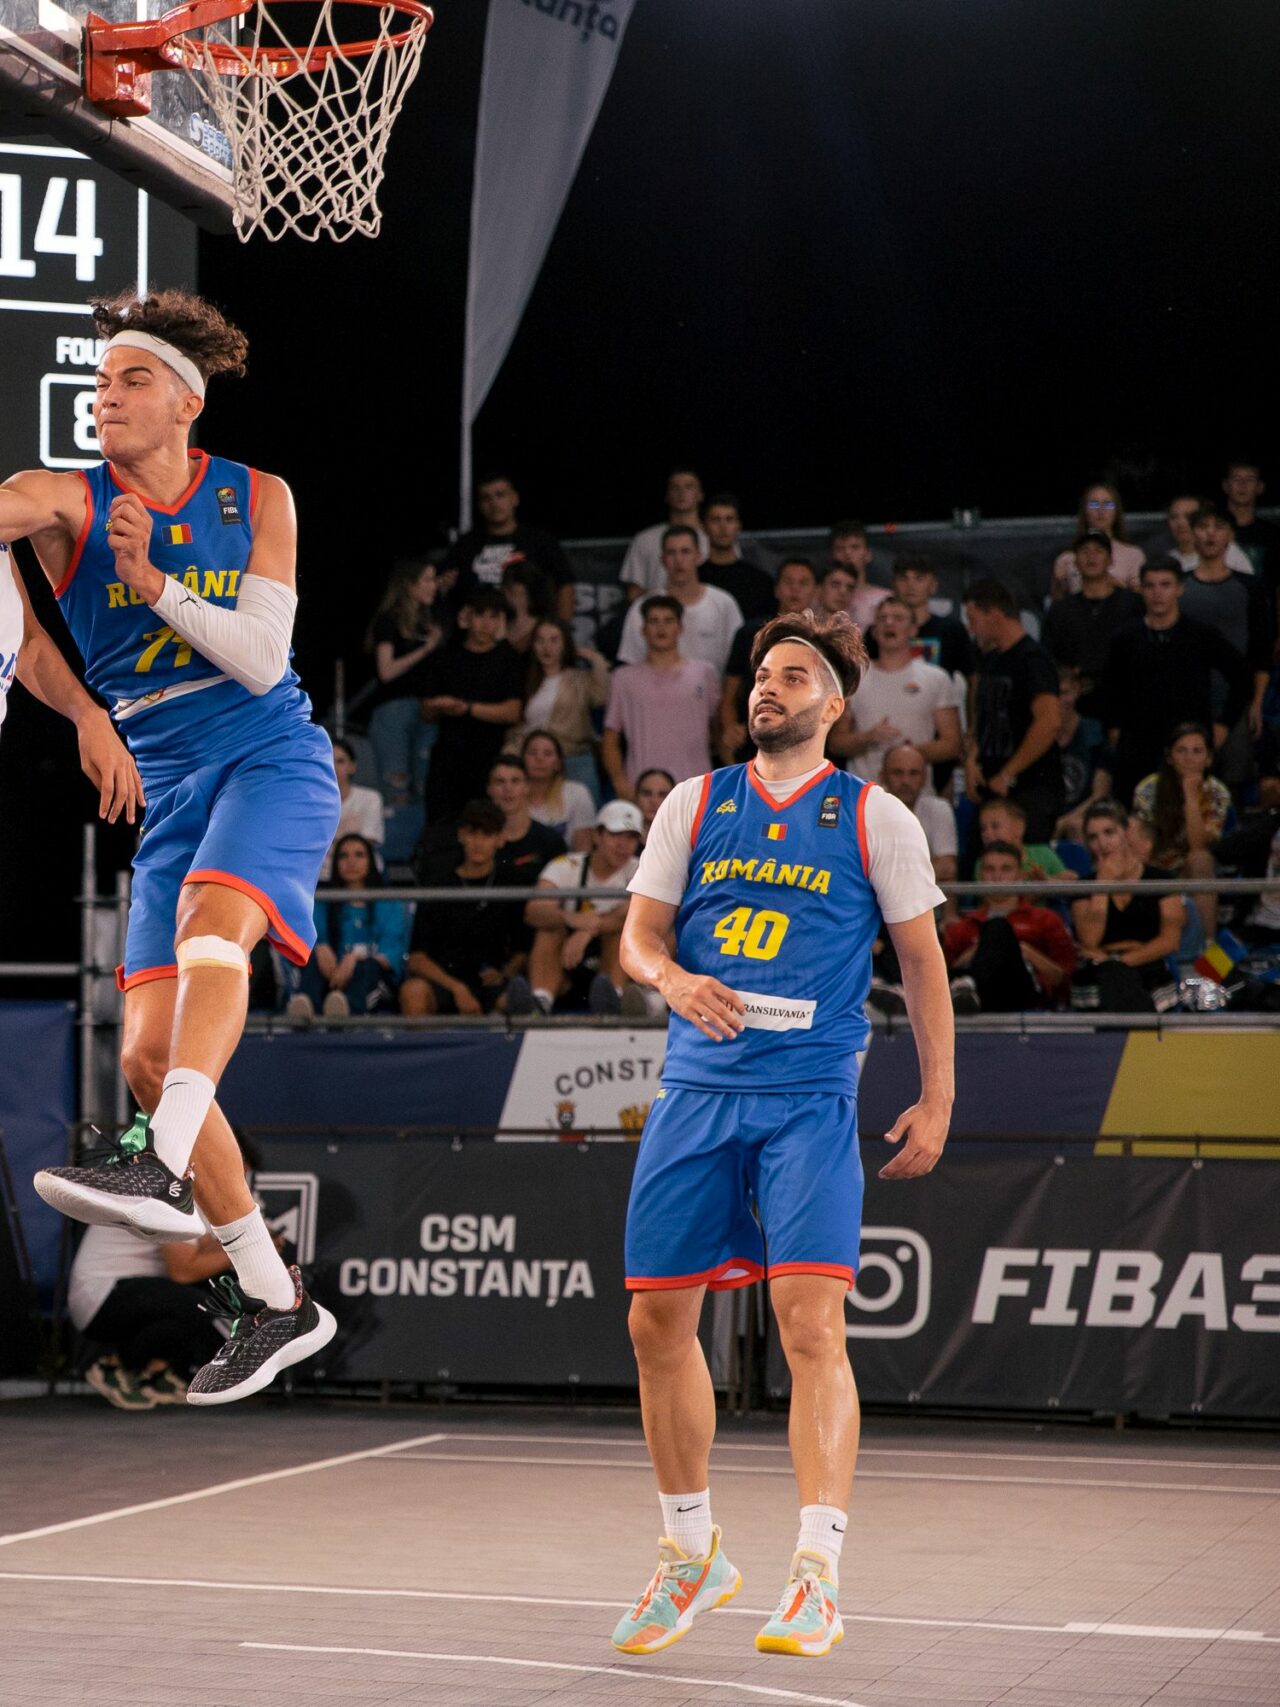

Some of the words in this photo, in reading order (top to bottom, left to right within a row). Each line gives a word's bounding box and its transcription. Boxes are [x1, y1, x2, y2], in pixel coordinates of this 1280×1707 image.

[56, 336, 106, 366] FOU
[701, 858, 831, 895] ROMÂNIA
[713, 907, 790, 960] 40
[743, 1003, 807, 1019] RANSILVANIA
[555, 1058, 664, 1096] CONST
[420, 1213, 517, 1253] CSM
